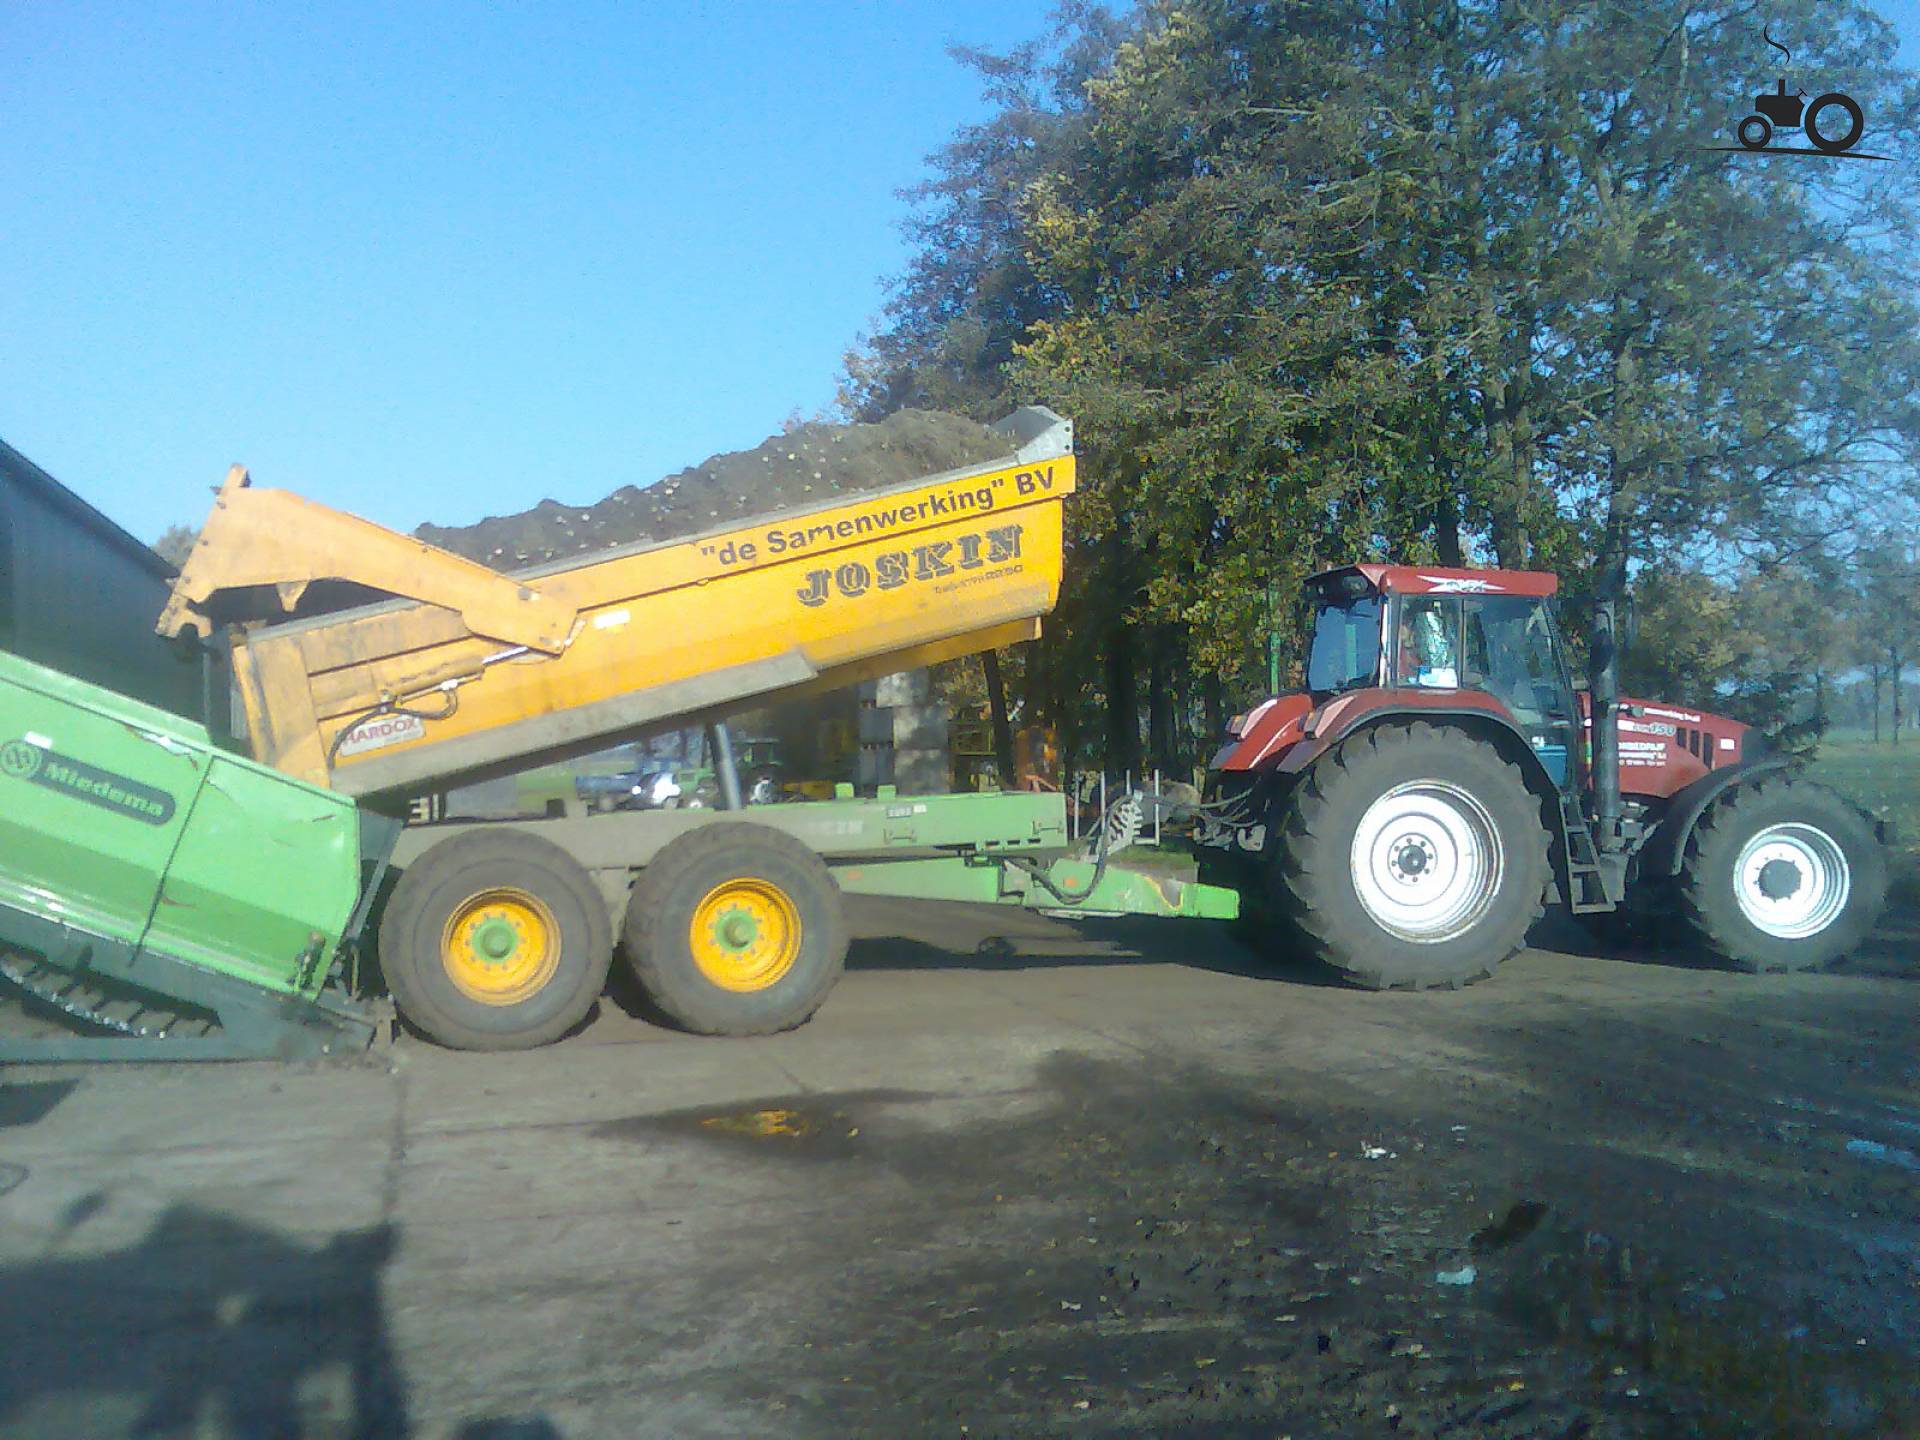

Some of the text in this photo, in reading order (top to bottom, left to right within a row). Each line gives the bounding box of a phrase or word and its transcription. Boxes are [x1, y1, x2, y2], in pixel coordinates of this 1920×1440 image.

[700, 539, 757, 567] "de
[1017, 465, 1055, 497] BV
[796, 523, 1025, 608] JOSKIN
